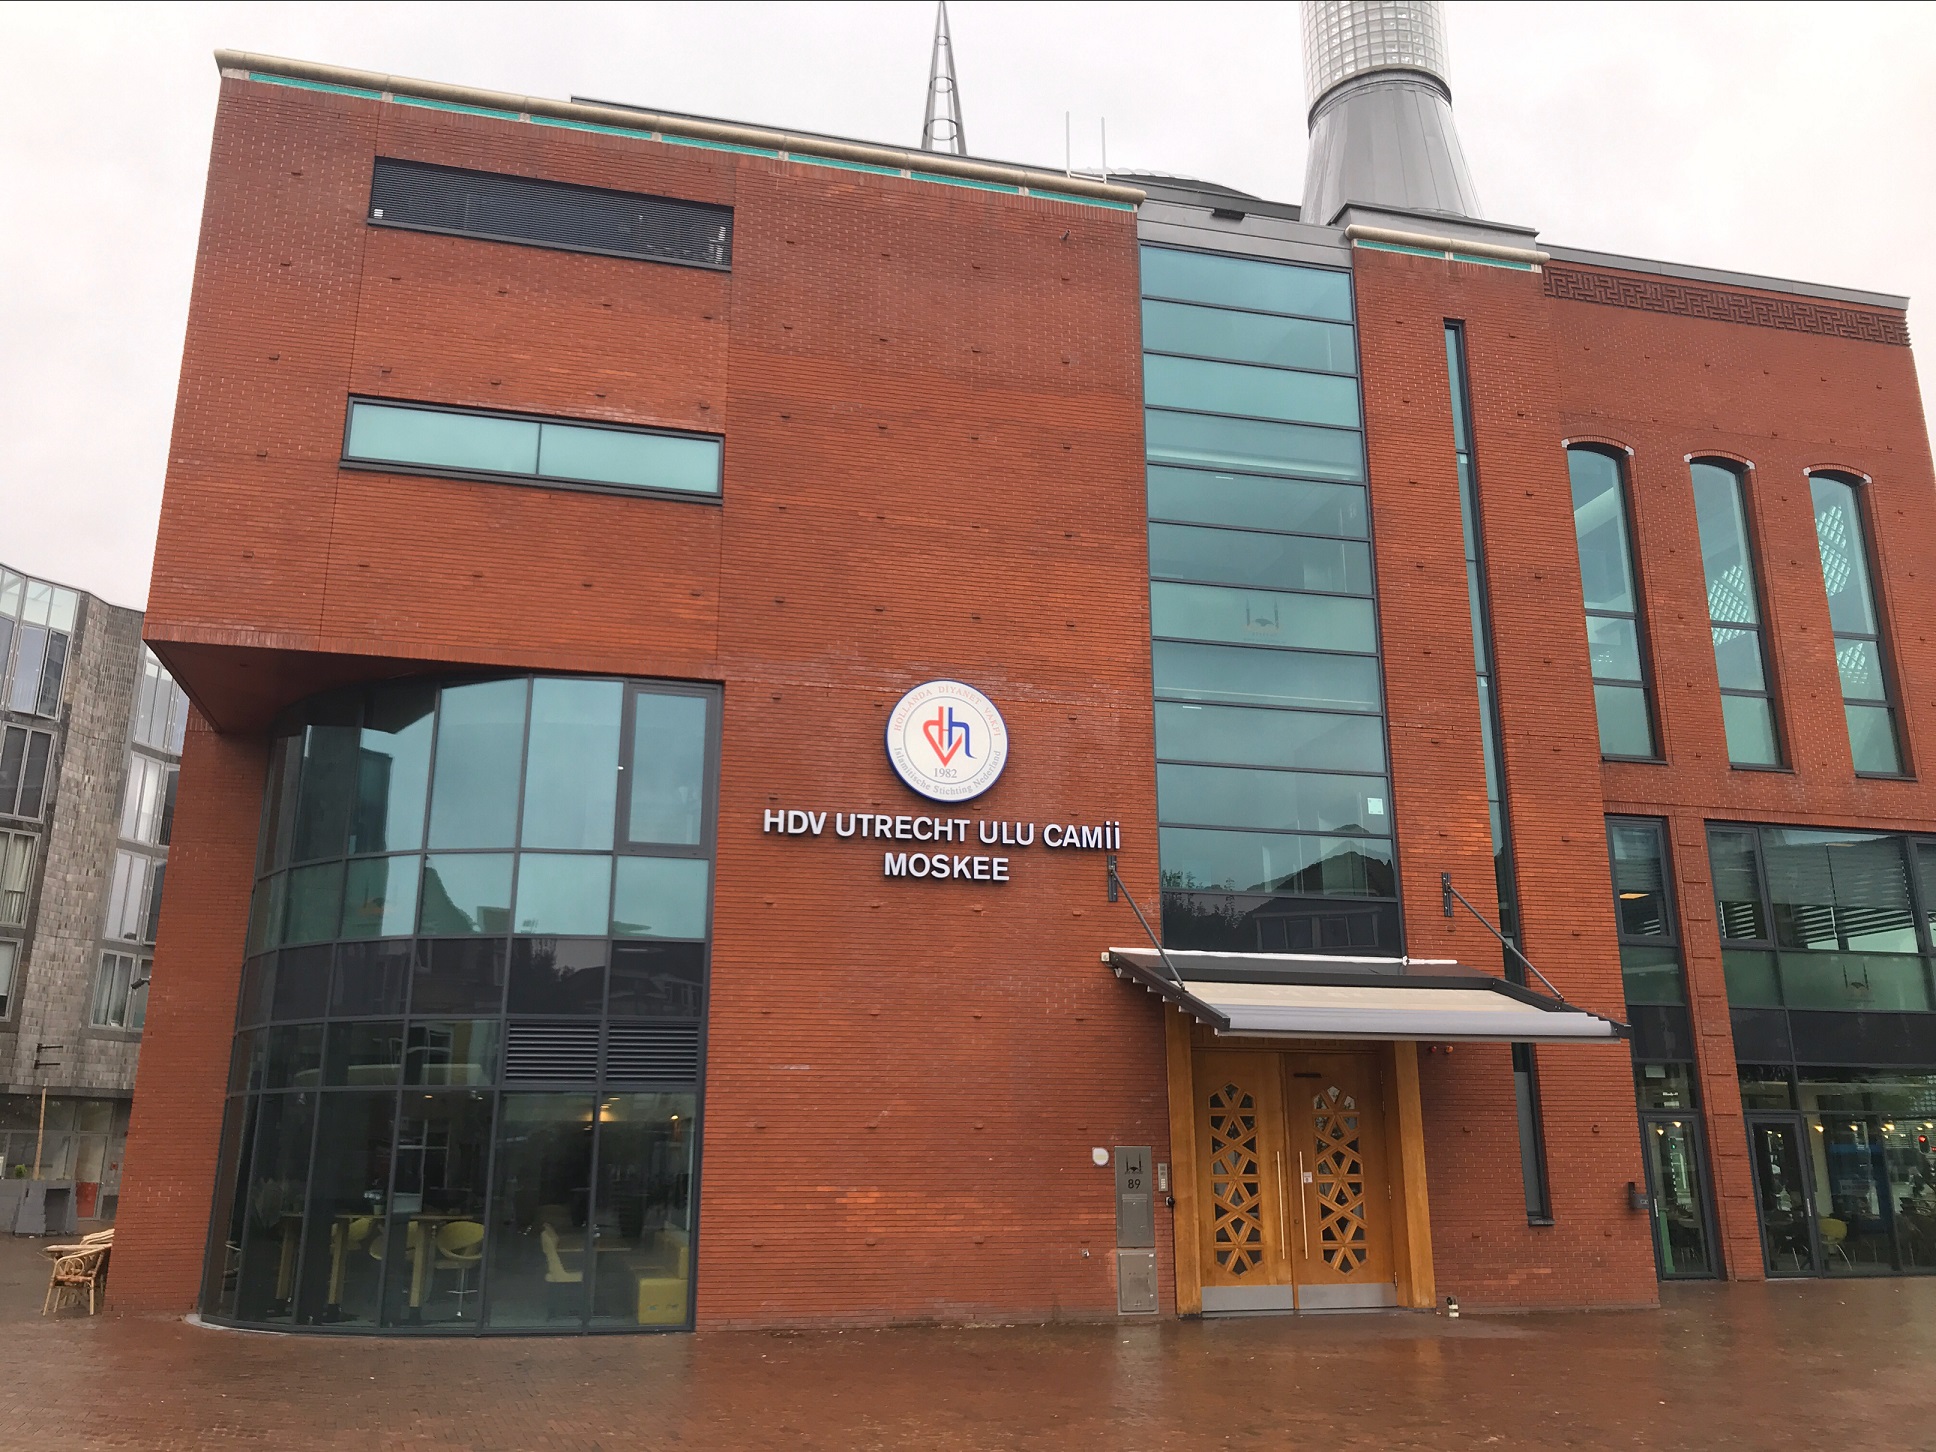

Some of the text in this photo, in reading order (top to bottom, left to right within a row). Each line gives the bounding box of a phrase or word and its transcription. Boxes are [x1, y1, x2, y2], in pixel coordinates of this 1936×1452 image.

[894, 689, 932, 731] HOLLANDA
[983, 707, 1001, 736] VAKFI
[894, 747, 1001, 795] Islamitische Stichting Nederland
[934, 767, 957, 778] 1982
[763, 809, 827, 835] HDV
[835, 813, 970, 842] UTRECHT
[979, 820, 1034, 845] ULU
[884, 852, 1010, 881] MOSKEE
[1128, 1178, 1140, 1189] 89
